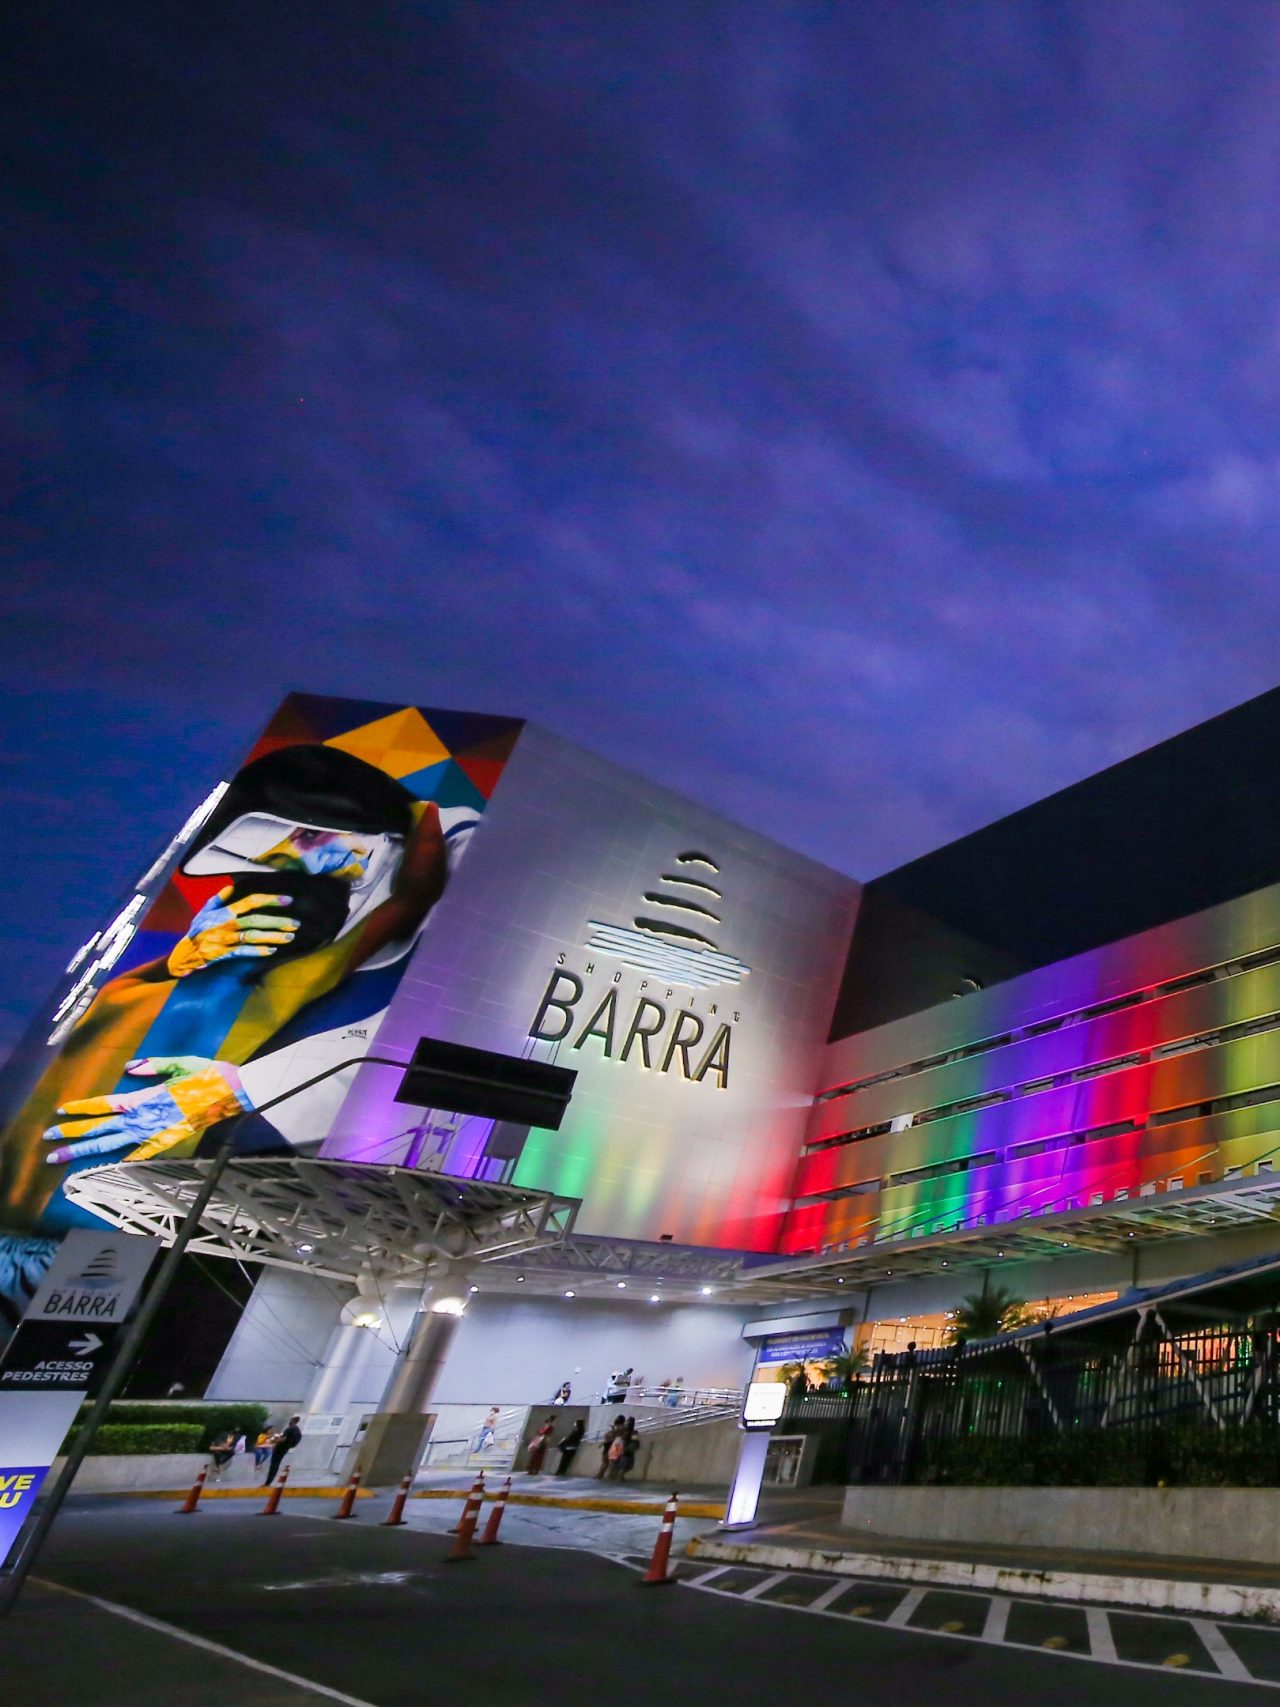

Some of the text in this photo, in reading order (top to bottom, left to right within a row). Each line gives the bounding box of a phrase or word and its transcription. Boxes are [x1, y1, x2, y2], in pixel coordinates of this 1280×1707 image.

[557, 953, 741, 1022] SHOPPING
[528, 968, 732, 1089] BARRA
[43, 1294, 117, 1317] BARRA
[2, 1371, 90, 1381] PEDESTRES
[34, 1361, 94, 1371] ACESSO
